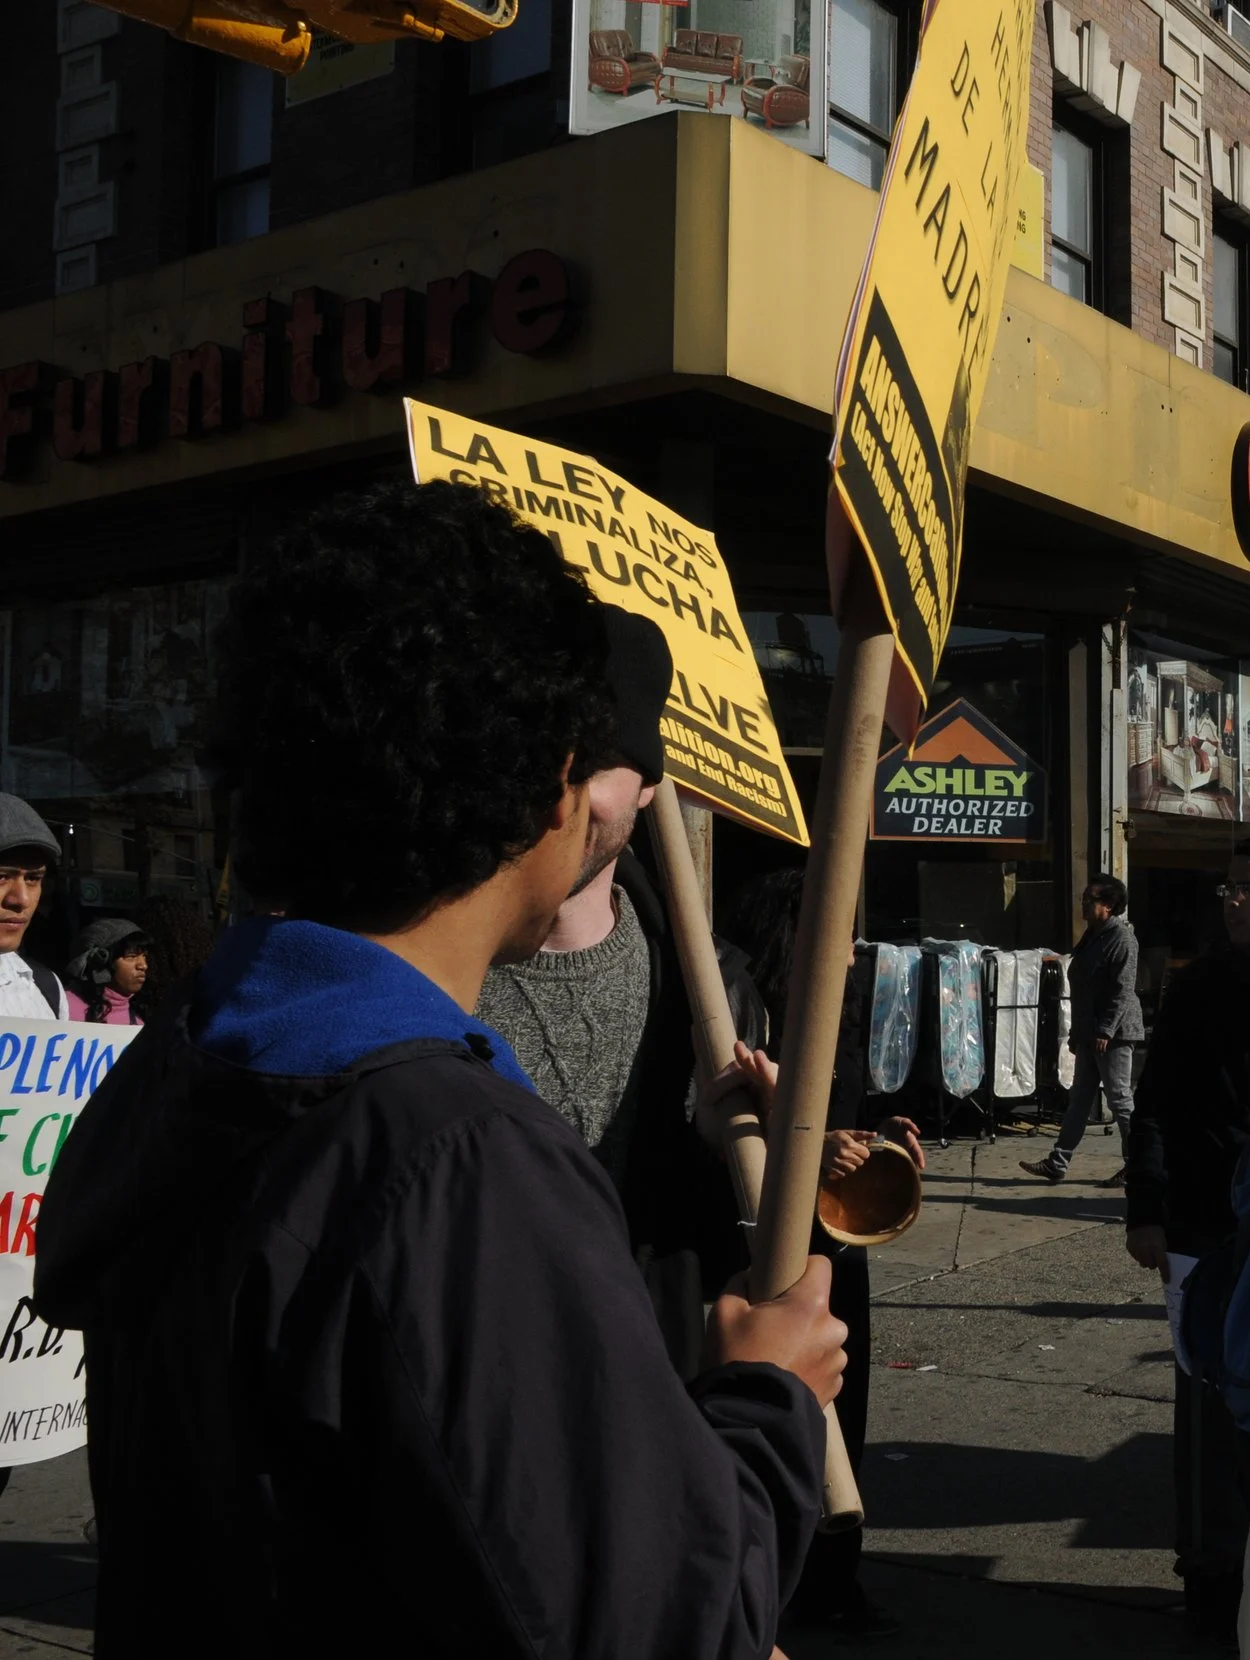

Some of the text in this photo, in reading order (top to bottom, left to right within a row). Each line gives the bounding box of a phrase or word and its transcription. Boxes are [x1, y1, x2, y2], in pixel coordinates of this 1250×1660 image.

[951, 39, 979, 136] DE
[0, 249, 570, 480] Furniture
[427, 415, 718, 569] LA LEY NOS
[872, 445, 896, 515] Now
[891, 492, 913, 558] Stop
[664, 744, 697, 770] and
[696, 758, 727, 787] End
[883, 765, 1034, 797] ASHLEY
[885, 797, 1035, 817] AUTHORIZED
[911, 816, 1004, 836] DEALER
